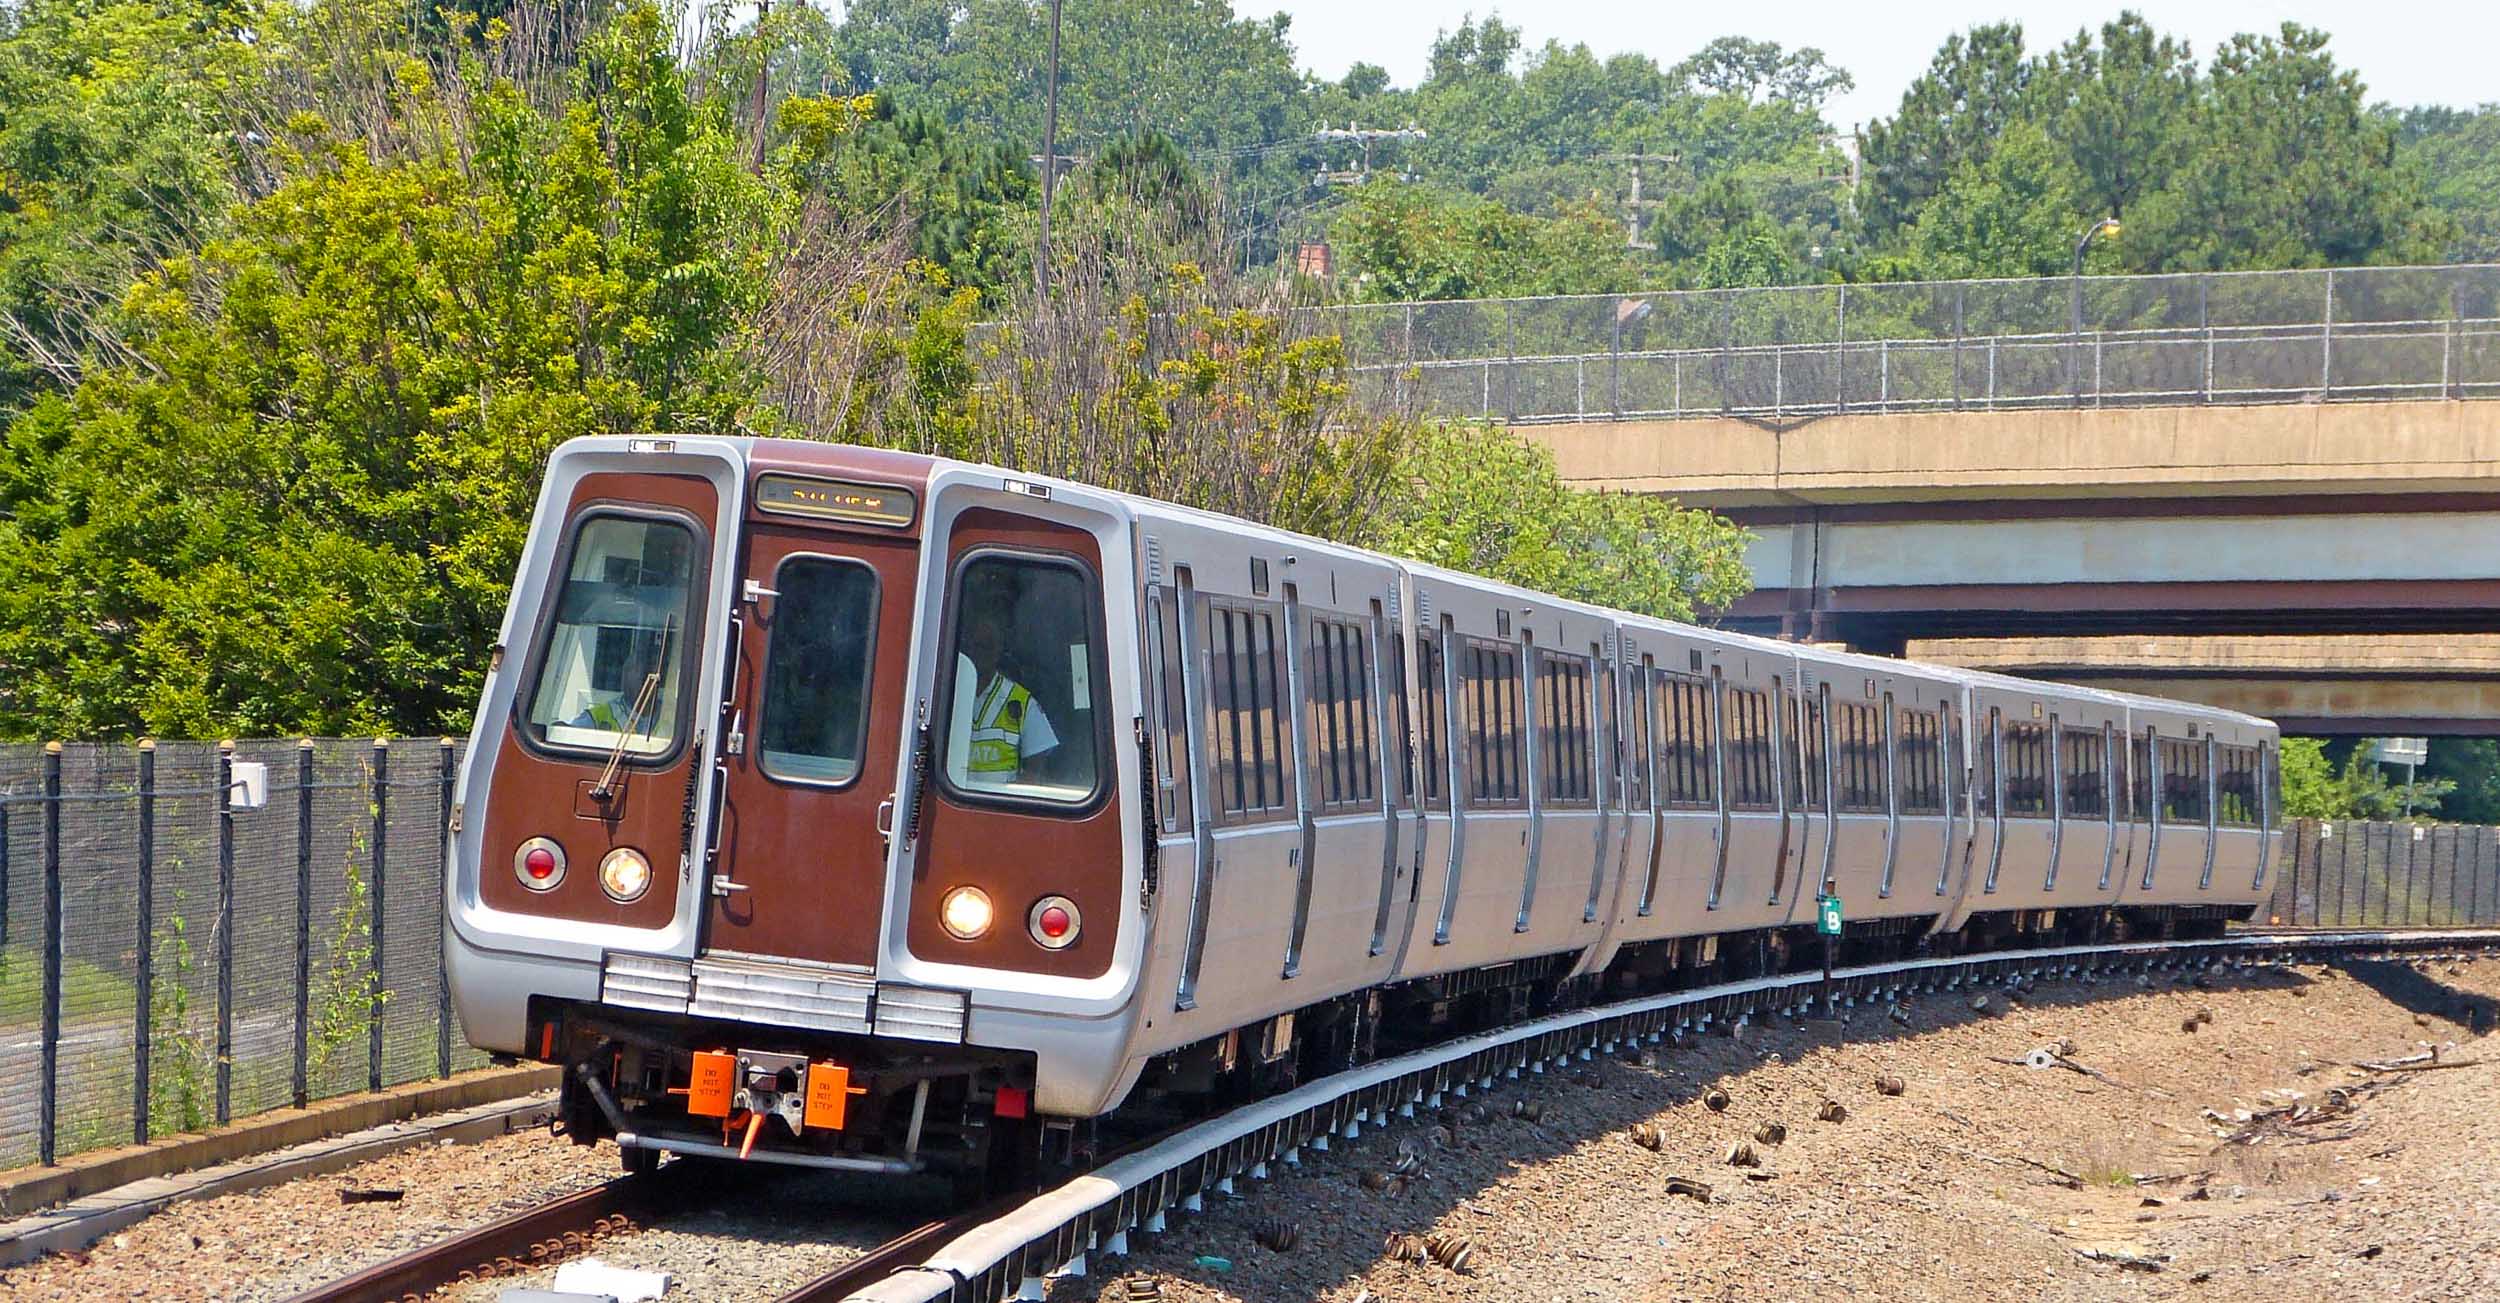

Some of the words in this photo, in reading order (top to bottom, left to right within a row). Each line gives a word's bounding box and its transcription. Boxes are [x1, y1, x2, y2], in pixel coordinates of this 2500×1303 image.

[1828, 911, 1840, 930] B
[704, 1068, 717, 1077] DO
[703, 1079, 719, 1087] NOT
[819, 1082, 830, 1090] DO
[699, 1088, 720, 1096] STEP
[816, 1092, 832, 1101] NOT
[813, 1101, 833, 1110] STEP
